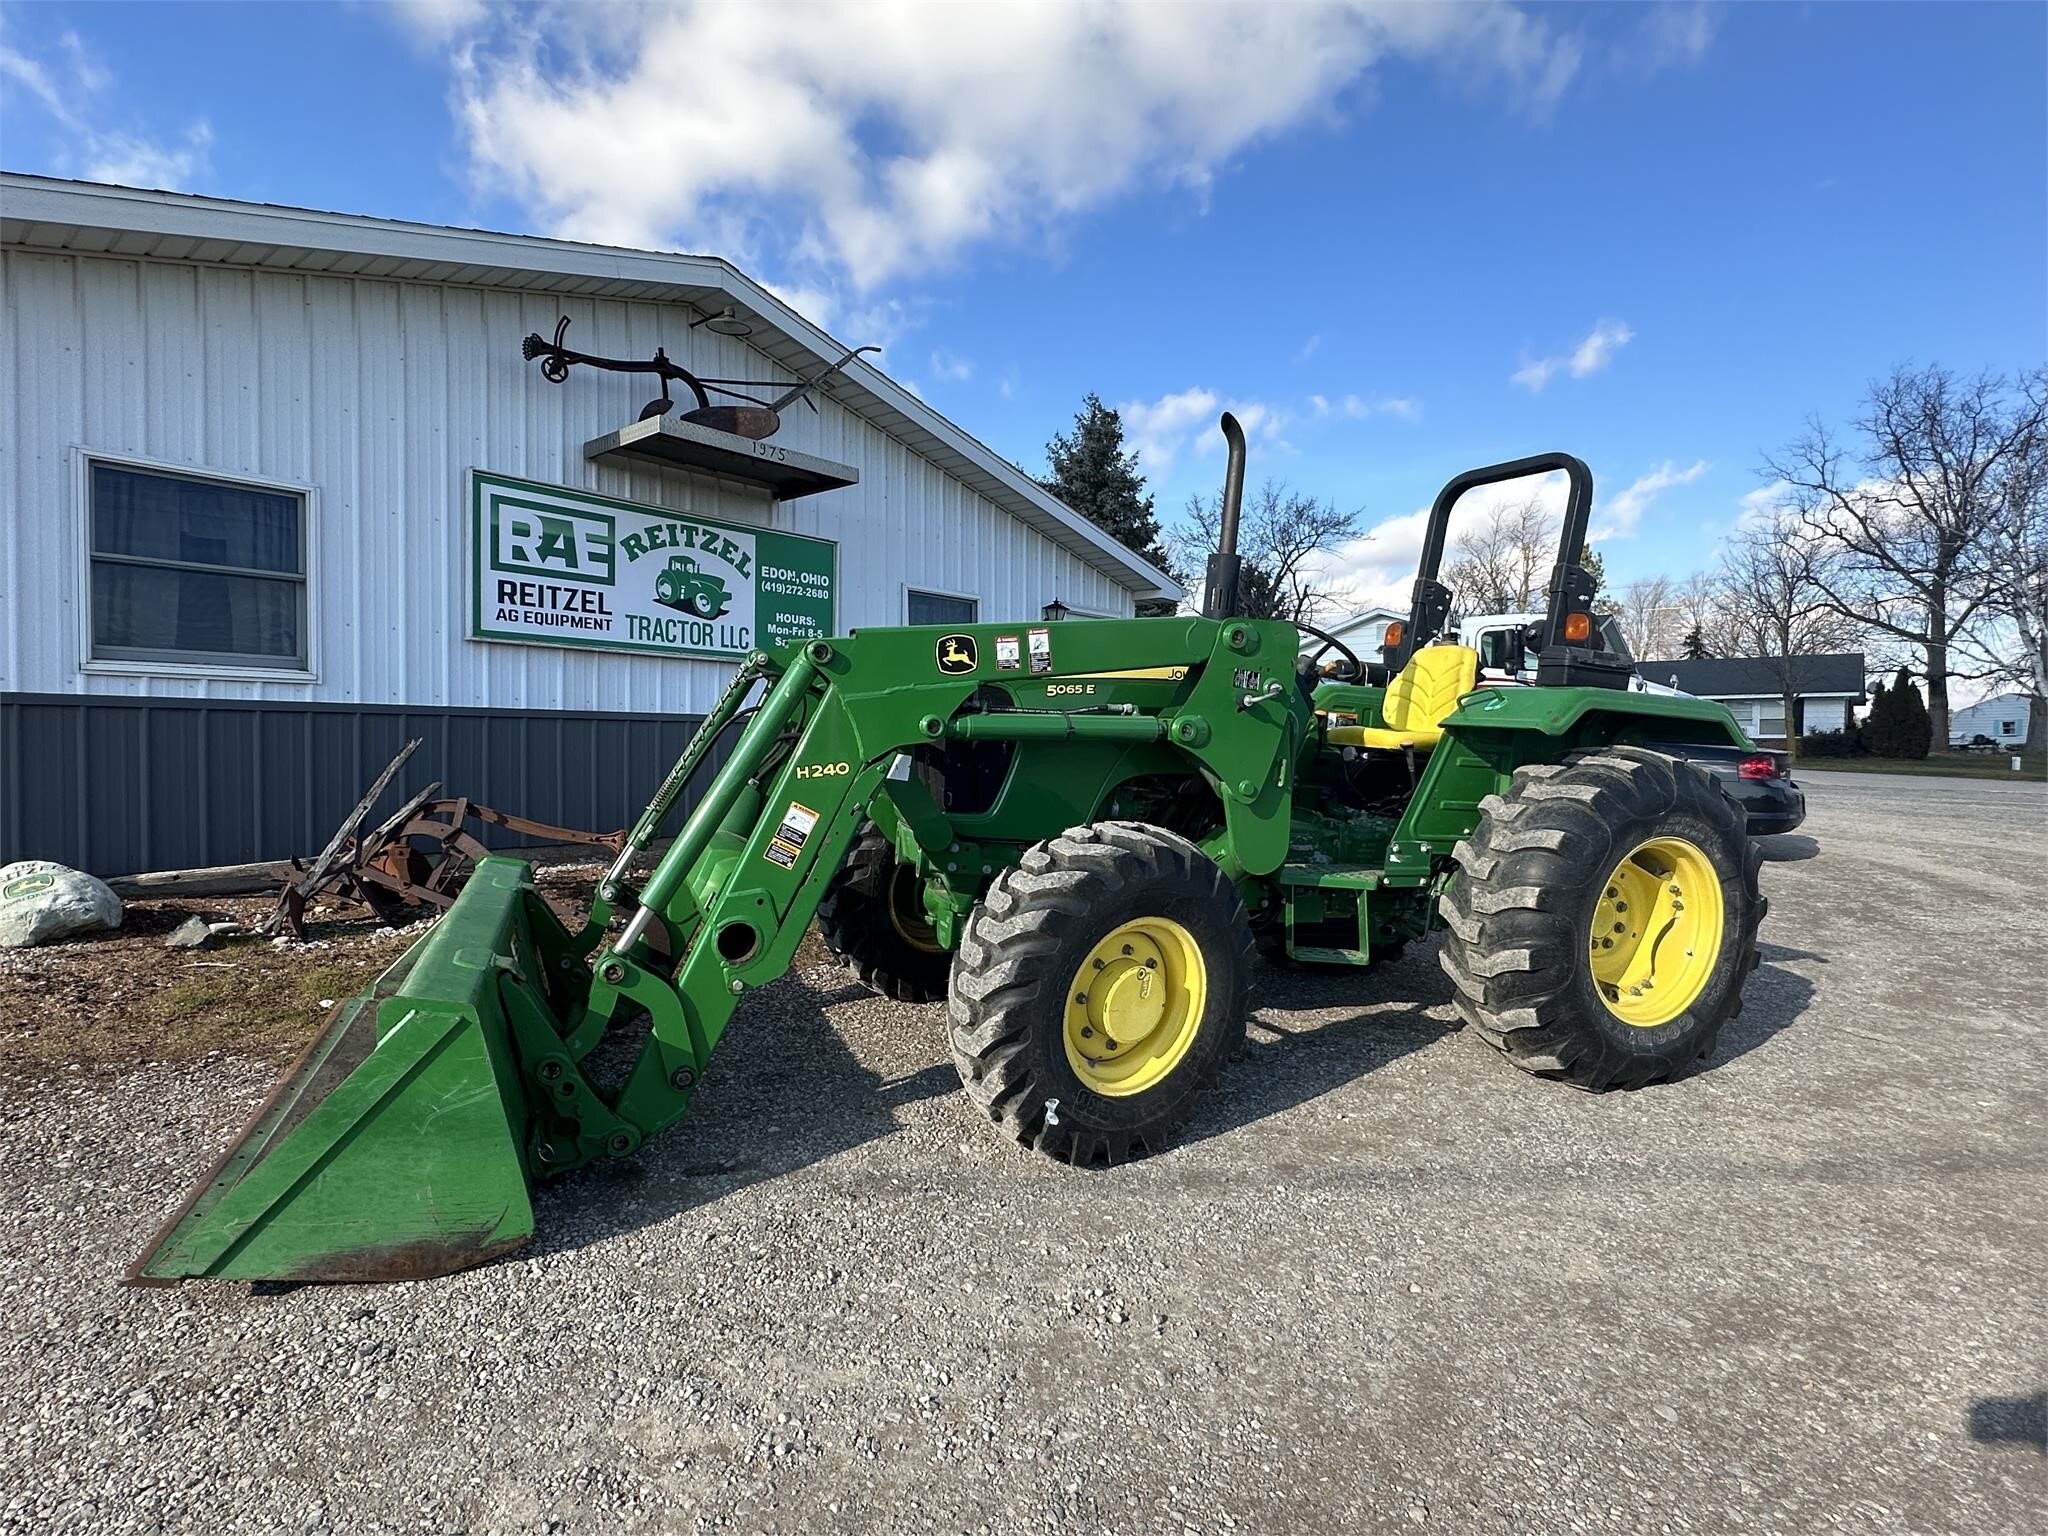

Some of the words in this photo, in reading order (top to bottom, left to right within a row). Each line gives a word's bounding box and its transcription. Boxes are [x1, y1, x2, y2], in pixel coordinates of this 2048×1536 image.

[753, 441, 786, 461] 1975
[500, 507, 608, 577] RAE
[620, 523, 752, 580] REITZEL
[800, 572, 829, 586] OHIO
[497, 579, 613, 616] REITZEL
[496, 608, 519, 621] AG
[523, 610, 613, 631] EQUIPMENT
[776, 612, 816, 626] HOURS:
[625, 614, 714, 647] TRACTOR
[720, 625, 750, 650] LLC
[767, 624, 805, 637] Mon-Fri
[807, 628, 823, 638] 8-5
[1046, 684, 1083, 697] 5065
[1086, 684, 1096, 694] E
[796, 762, 850, 779] H240
